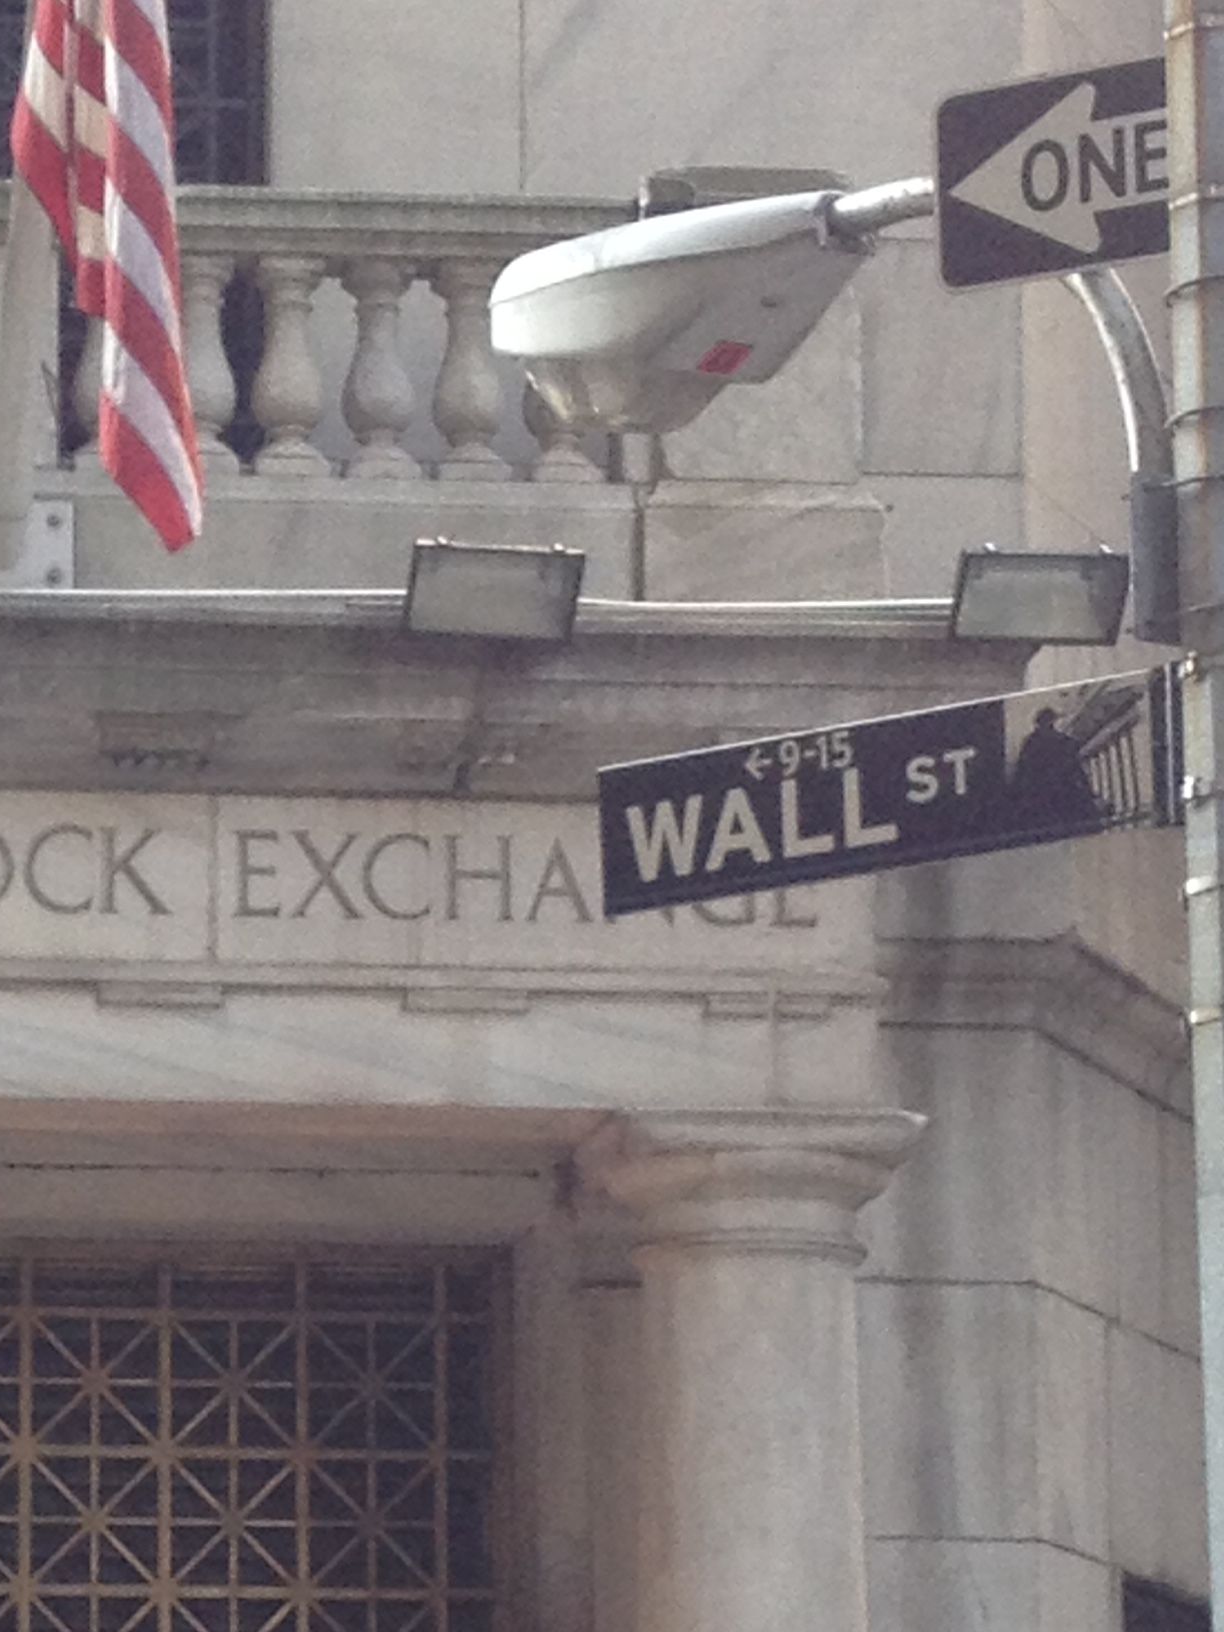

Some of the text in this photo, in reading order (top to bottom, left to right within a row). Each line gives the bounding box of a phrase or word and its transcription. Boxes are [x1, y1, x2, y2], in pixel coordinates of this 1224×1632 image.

[1022, 119, 1169, 211] ONE
[780, 730, 854, 776] 9-15
[626, 746, 976, 882] WALL ST
[232, 829, 818, 929] EXCHA
